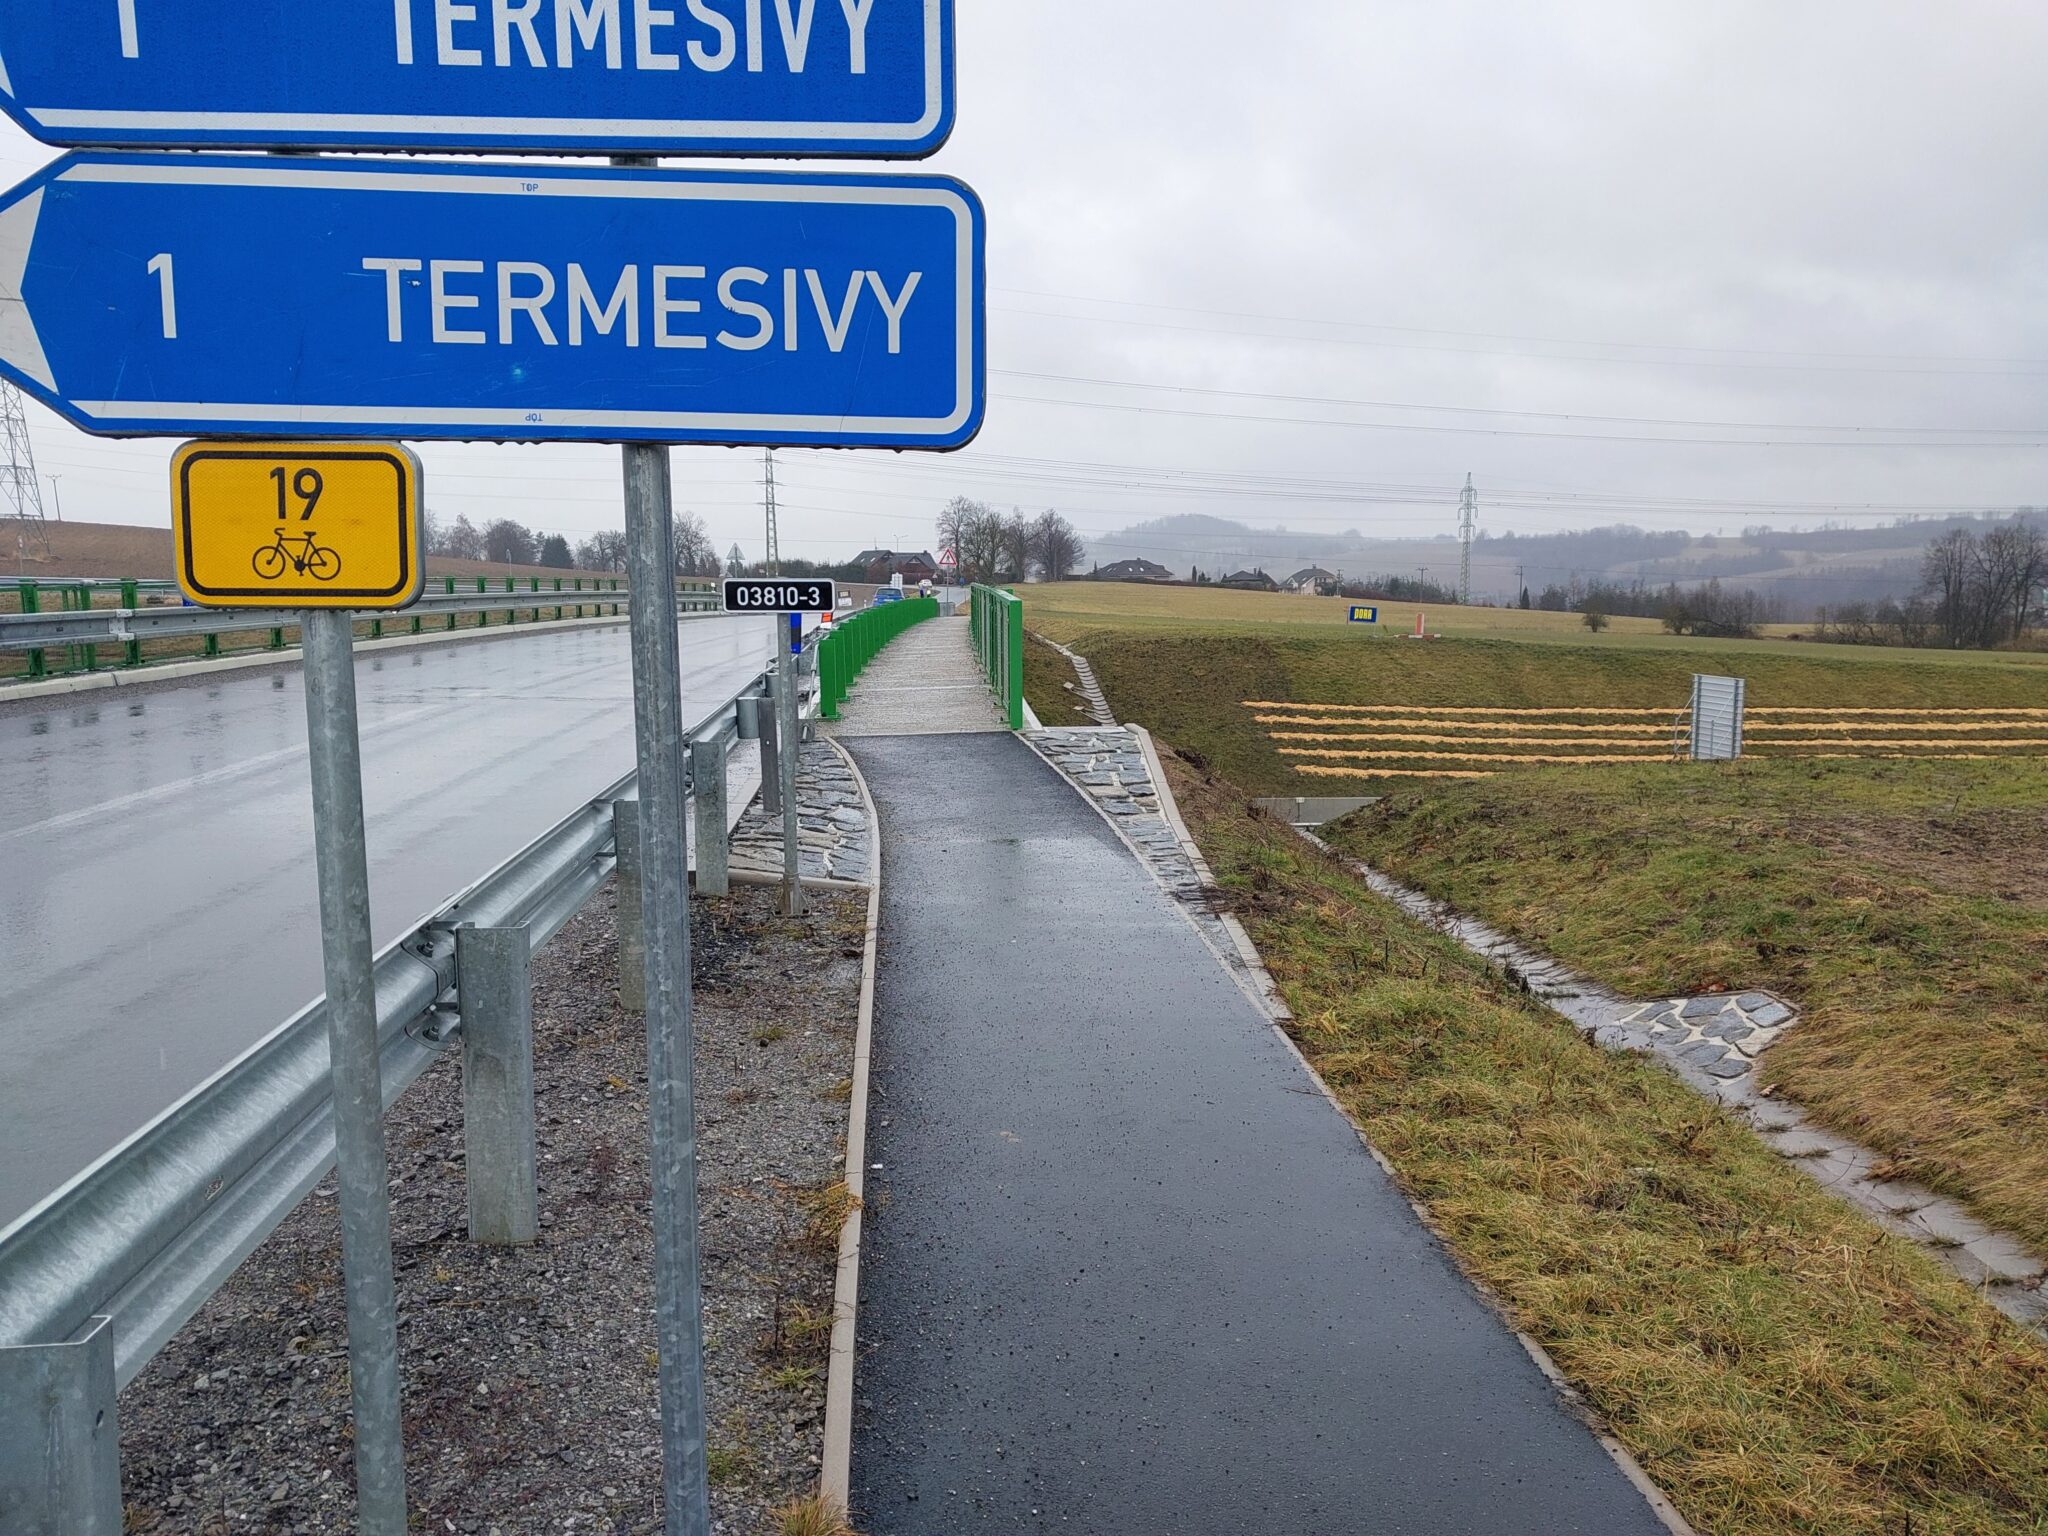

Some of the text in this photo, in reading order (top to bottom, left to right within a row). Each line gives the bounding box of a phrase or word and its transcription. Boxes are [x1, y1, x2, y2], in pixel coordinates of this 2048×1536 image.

[520, 183, 538, 192] TOP
[147, 253, 923, 354] 1 TERMESIVY
[270, 467, 325, 521] 19
[737, 586, 820, 606] 03810-3
